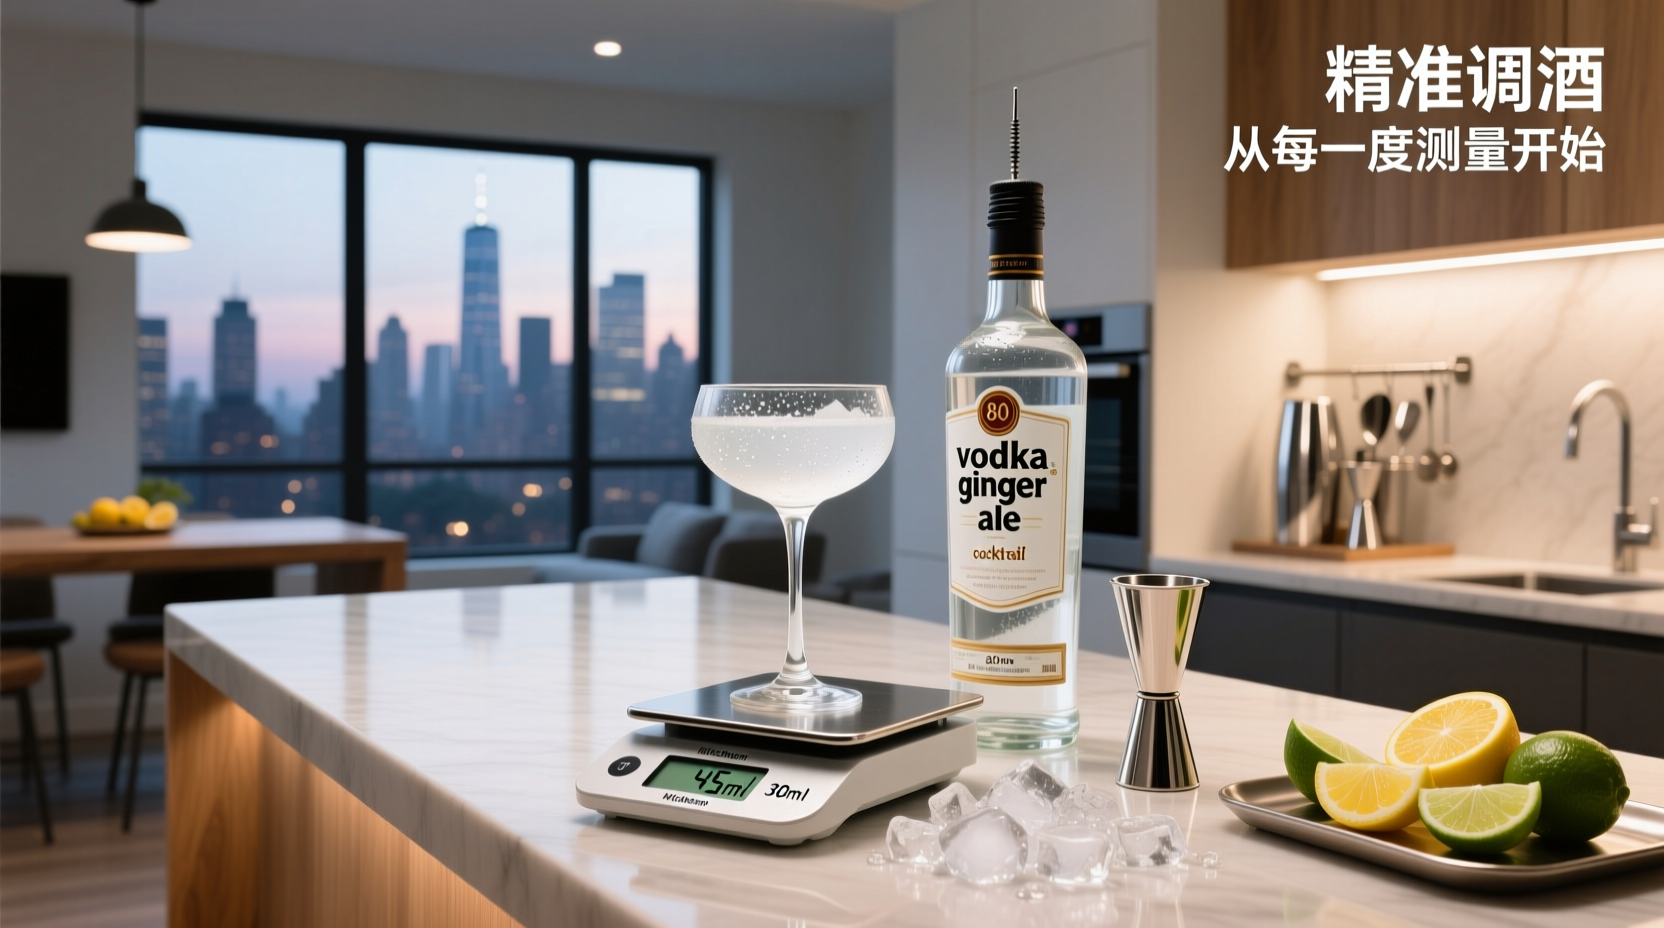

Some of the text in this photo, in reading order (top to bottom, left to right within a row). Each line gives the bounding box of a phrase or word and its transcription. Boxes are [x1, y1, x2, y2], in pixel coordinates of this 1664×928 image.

[986, 402, 1009, 422] 80
[956, 440, 1048, 470] vodka
[958, 470, 1047, 506] ginger
[978, 504, 1021, 532] ale
[694, 769, 757, 798] 45ml
[764, 783, 810, 802] 30ml
